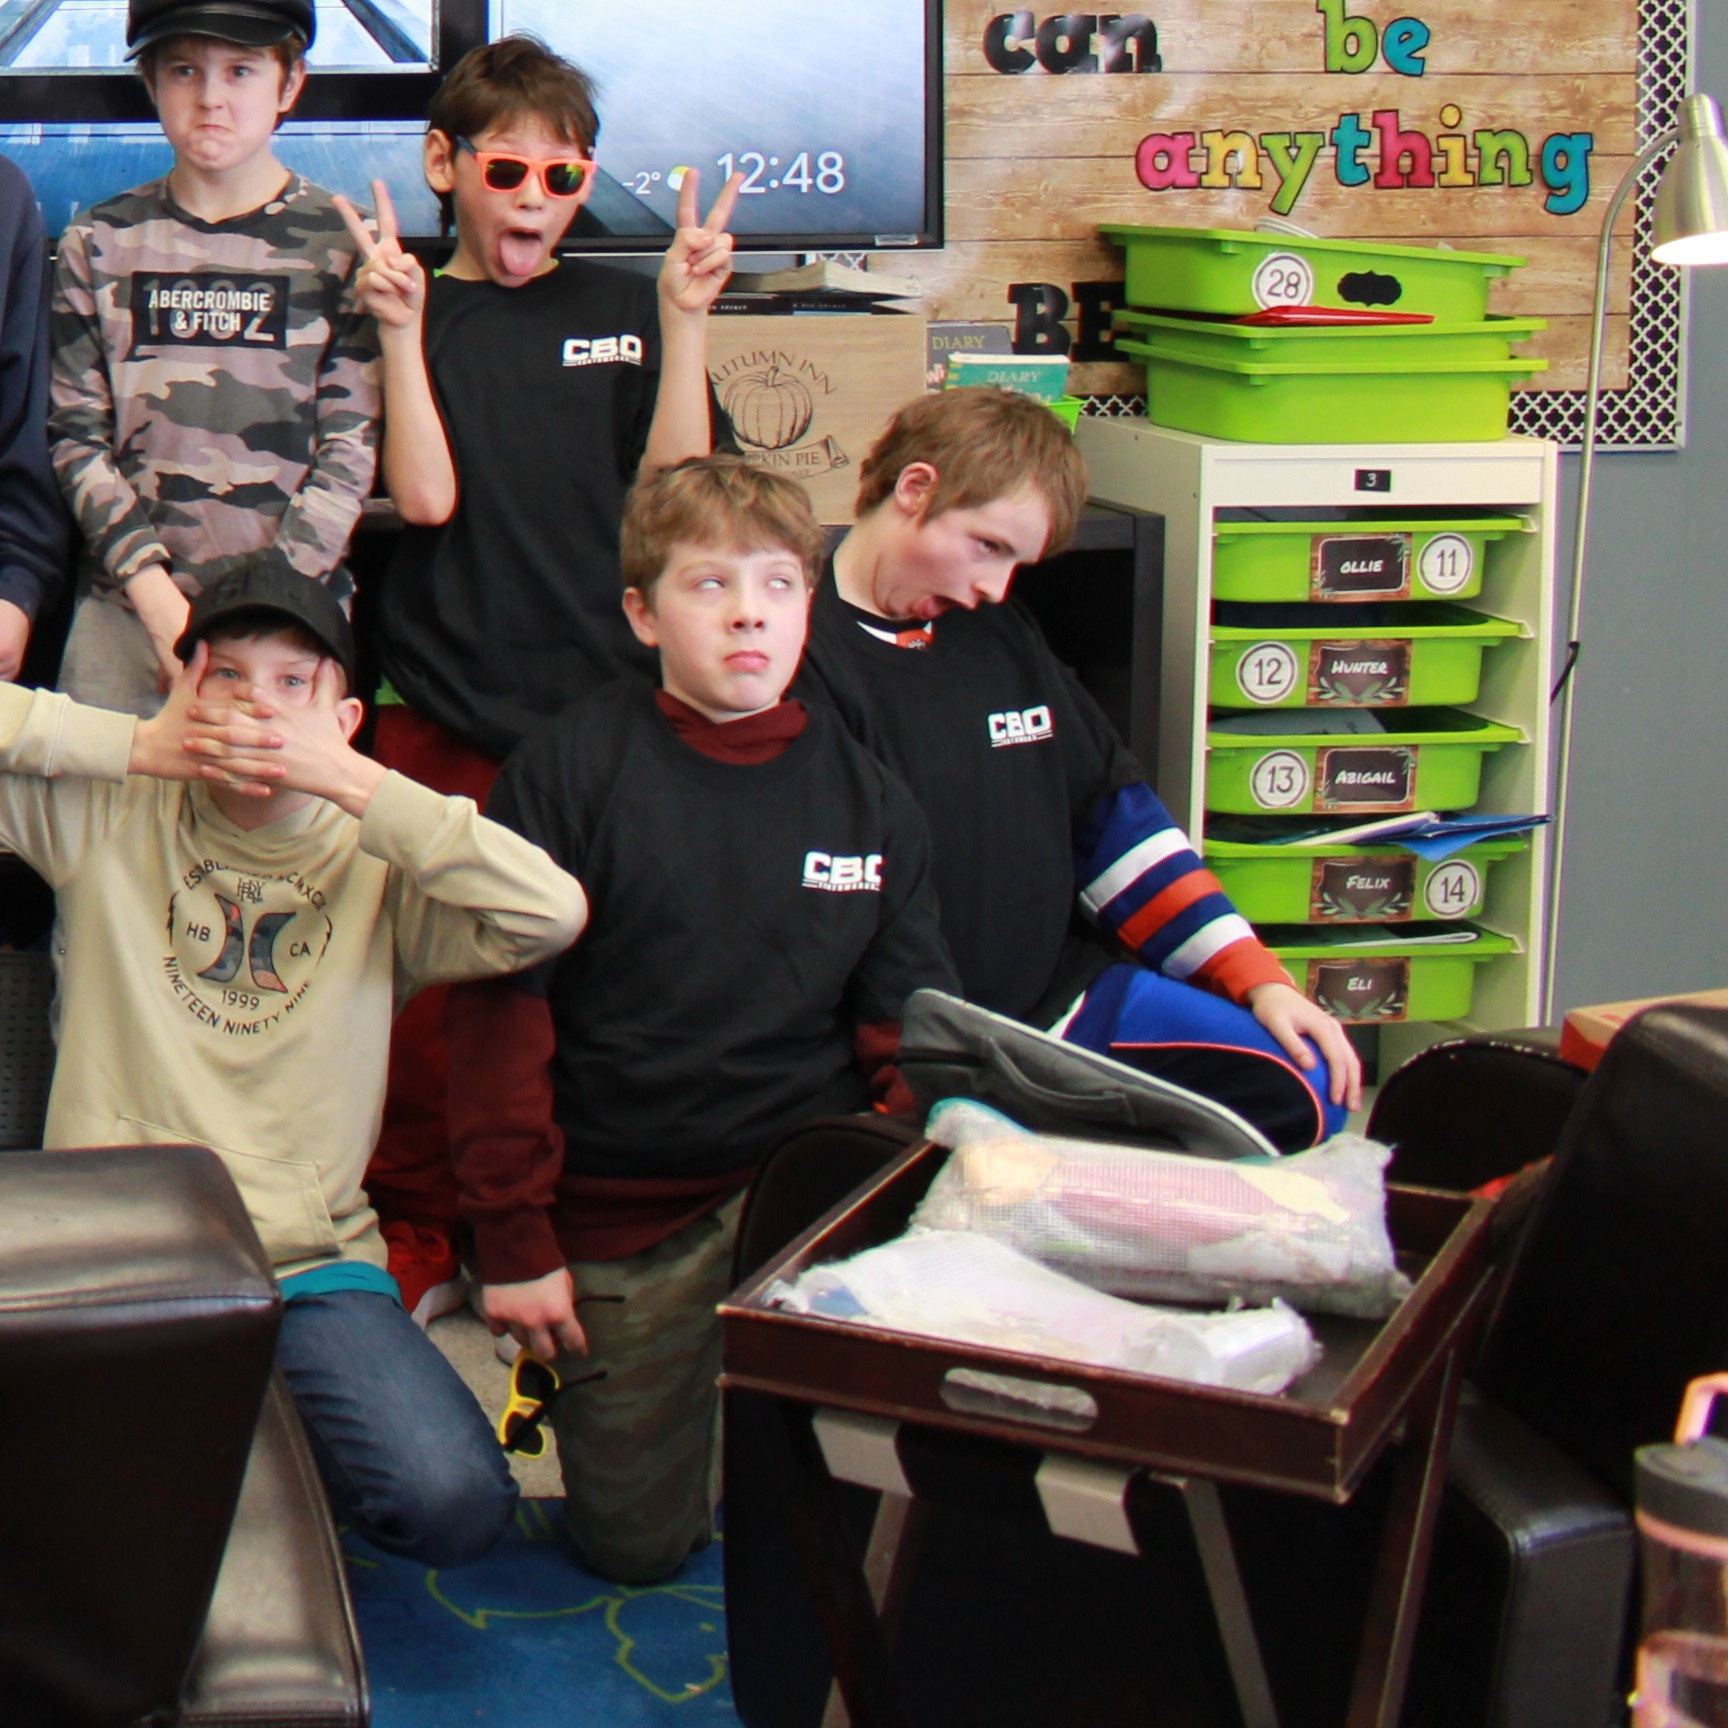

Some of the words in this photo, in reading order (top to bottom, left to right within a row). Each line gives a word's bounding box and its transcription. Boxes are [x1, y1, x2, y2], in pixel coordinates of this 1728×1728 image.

[982, 9, 1164, 75] can
[716, 151, 845, 194] 12:48
[1134, 102, 1593, 216] anything
[1267, 266, 1302, 302] 28
[148, 289, 272, 312] ABERCROMBIE
[175, 311, 187, 330] &
[193, 312, 241, 331] FITCH
[562, 334, 643, 361] CBO
[931, 335, 985, 350] DIARY
[799, 360, 837, 394] INN
[987, 371, 1042, 383] DIARY
[795, 451, 820, 466] PIE
[1365, 470, 1378, 488] 3
[1339, 558, 1384, 575] OLLIE
[1437, 548, 1458, 579] 11
[1254, 656, 1282, 687] 12
[987, 705, 1052, 740] CBO
[1266, 764, 1295, 795] 13
[1441, 874, 1466, 905] 14
[186, 922, 211, 942] HB
[290, 942, 311, 958] CA
[163, 955, 221, 1028] NINETEEN
[222, 1012, 280, 1036] NINETY
[221, 989, 260, 1011] 1999
